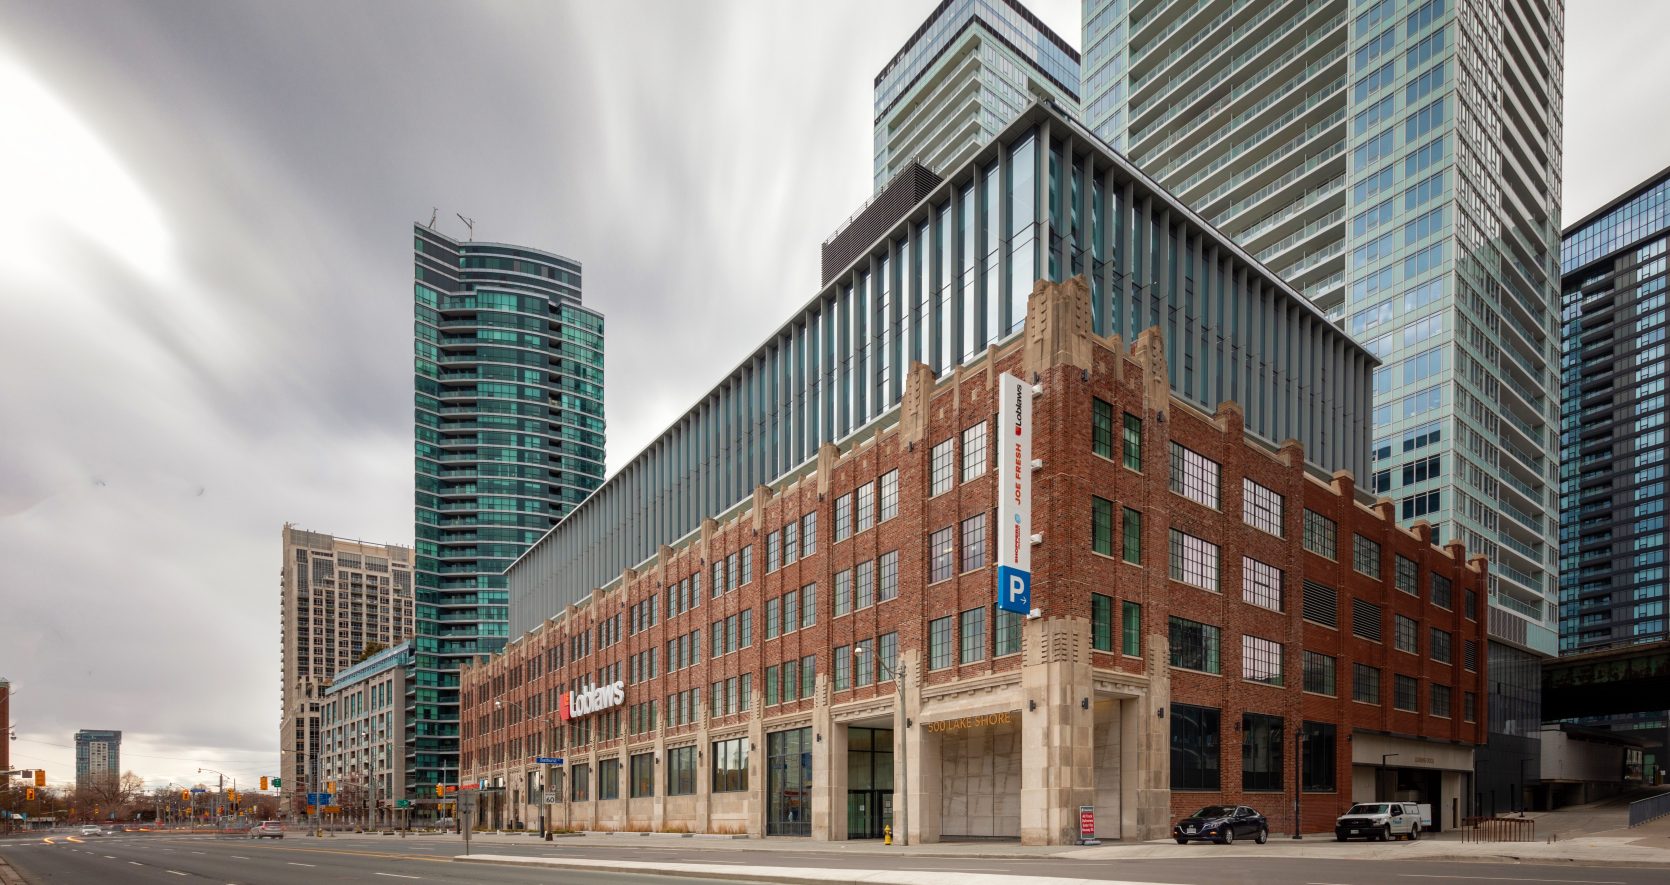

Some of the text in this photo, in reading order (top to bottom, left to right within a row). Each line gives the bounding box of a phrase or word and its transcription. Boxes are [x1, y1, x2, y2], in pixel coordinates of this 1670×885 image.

[1010, 574, 1025, 603] P
[569, 680, 625, 718] Loblaws
[928, 712, 1011, 733] 500 LAKE SHORE
